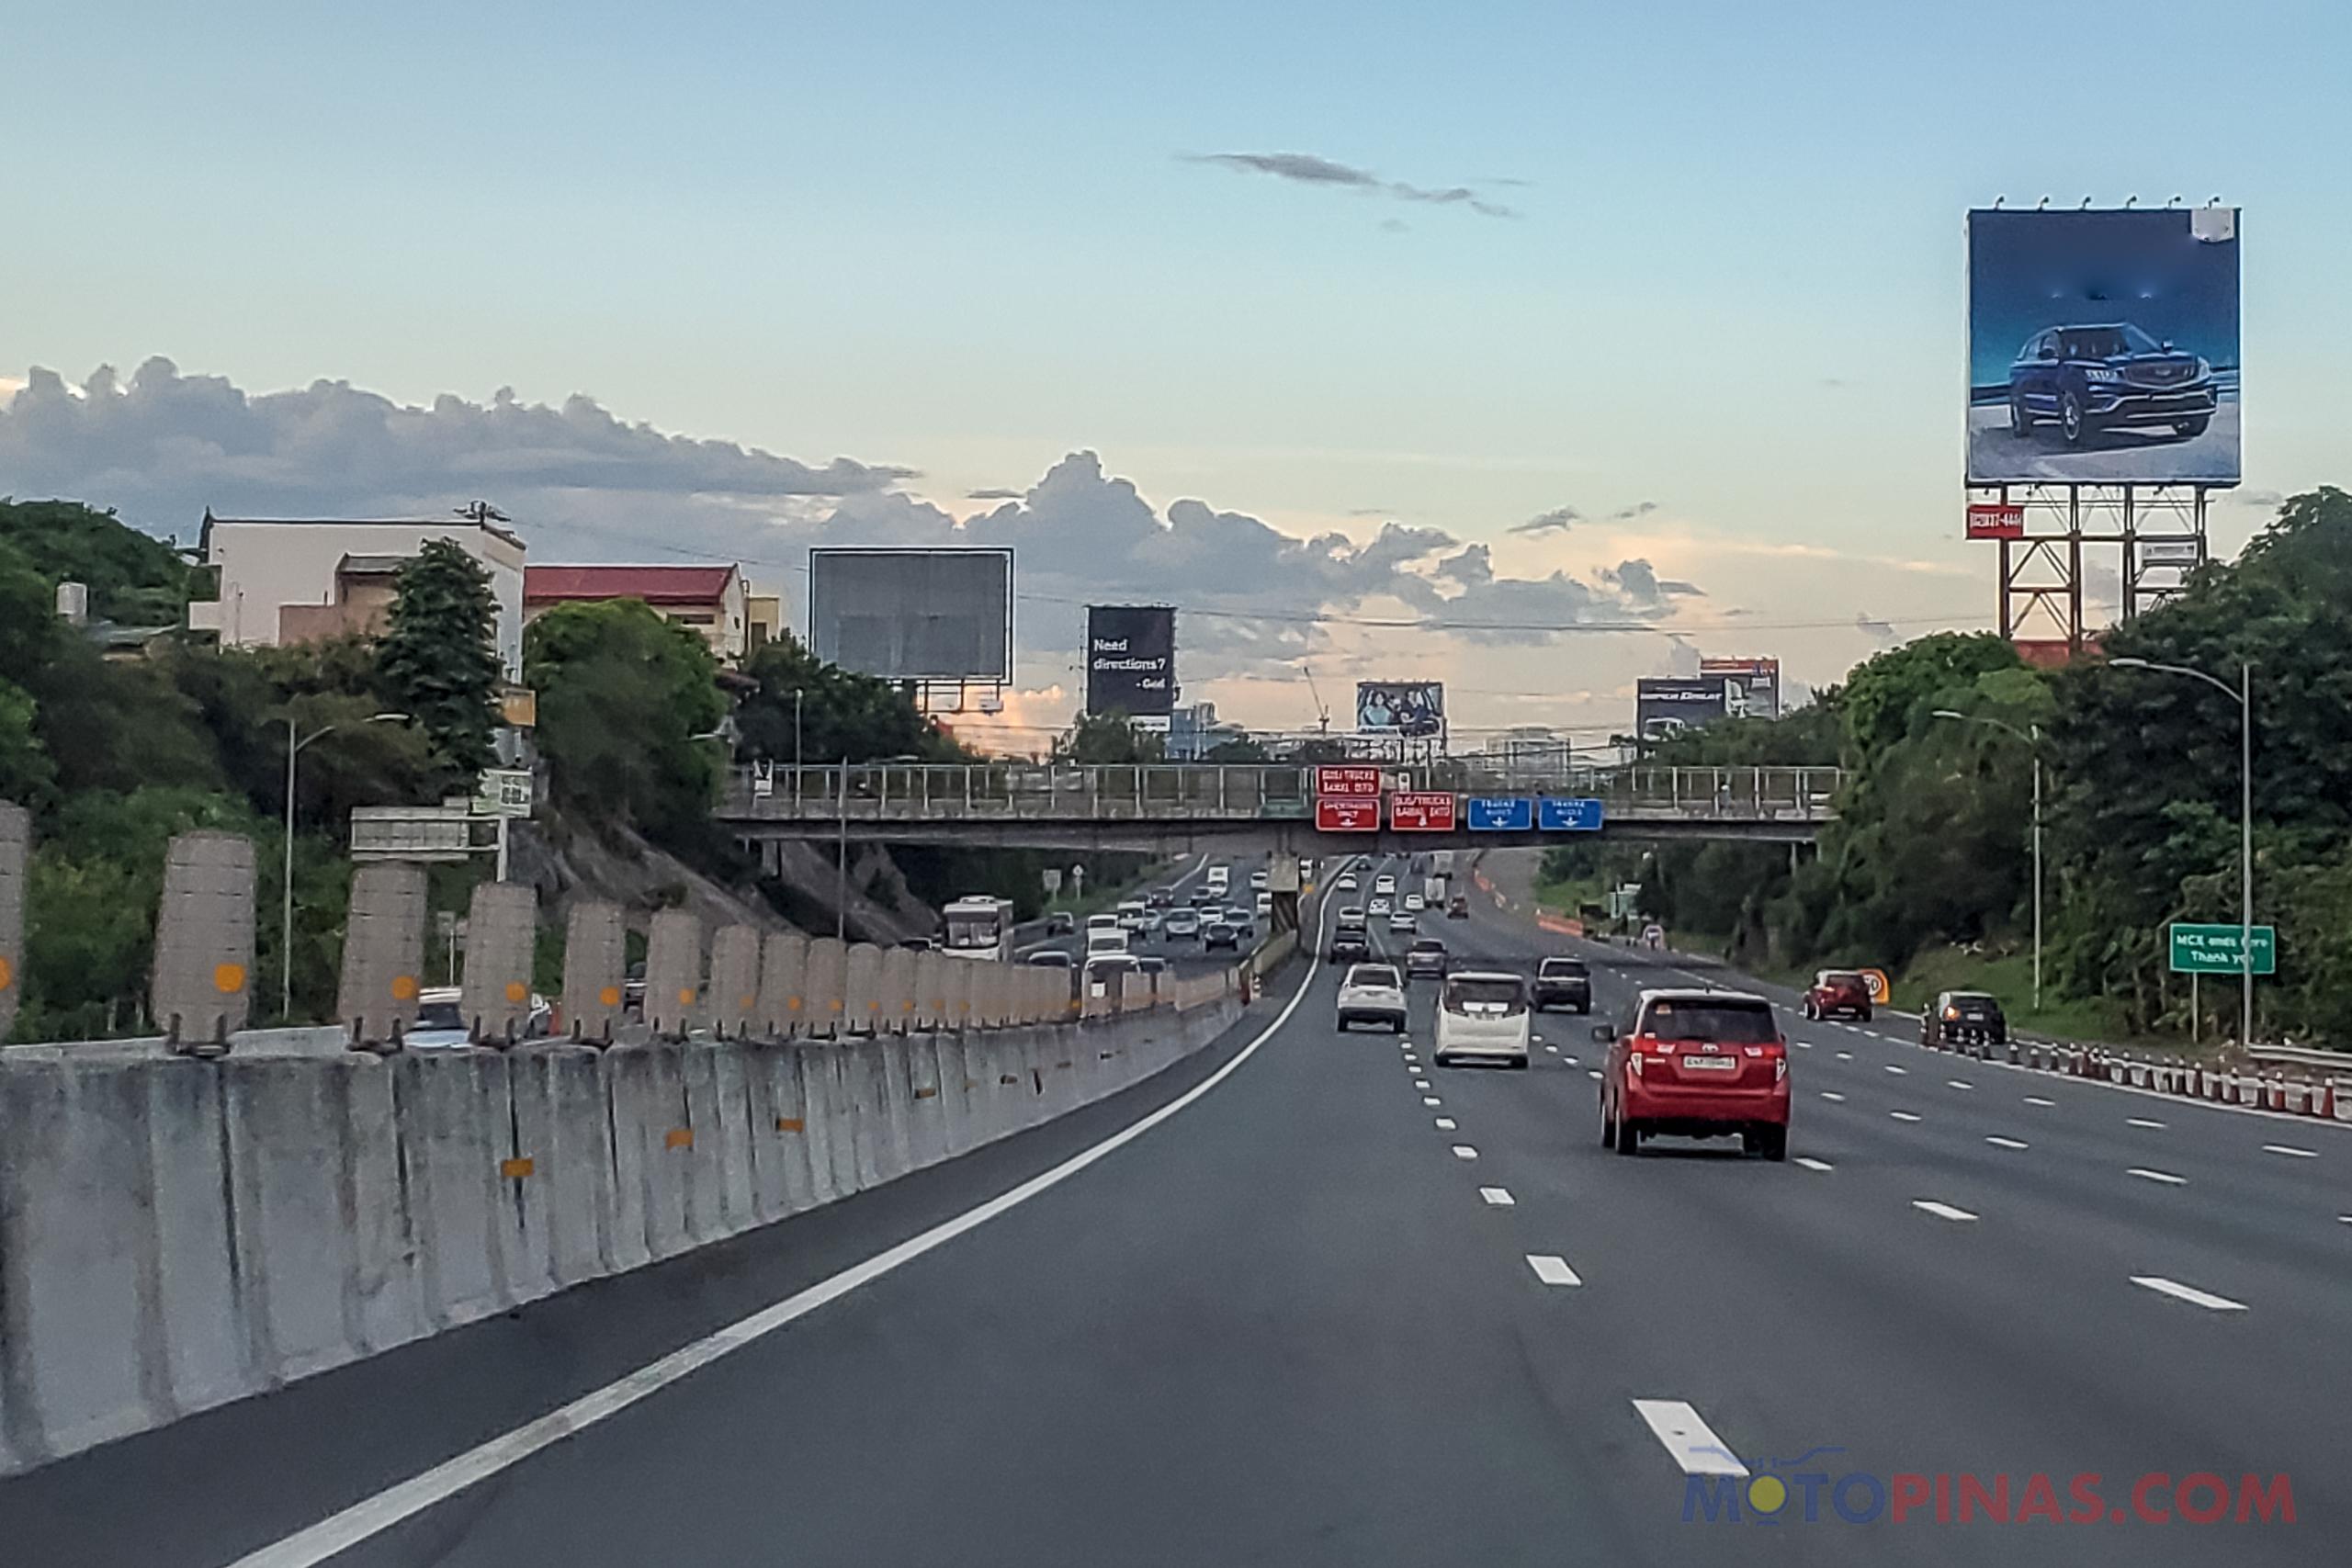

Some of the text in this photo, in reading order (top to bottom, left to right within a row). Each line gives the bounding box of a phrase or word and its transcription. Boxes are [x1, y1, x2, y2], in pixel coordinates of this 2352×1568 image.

[1093, 638, 1128, 651] Need
[1093, 658, 1166, 671] directions?
[2190, 951, 2228, 963] Thank
